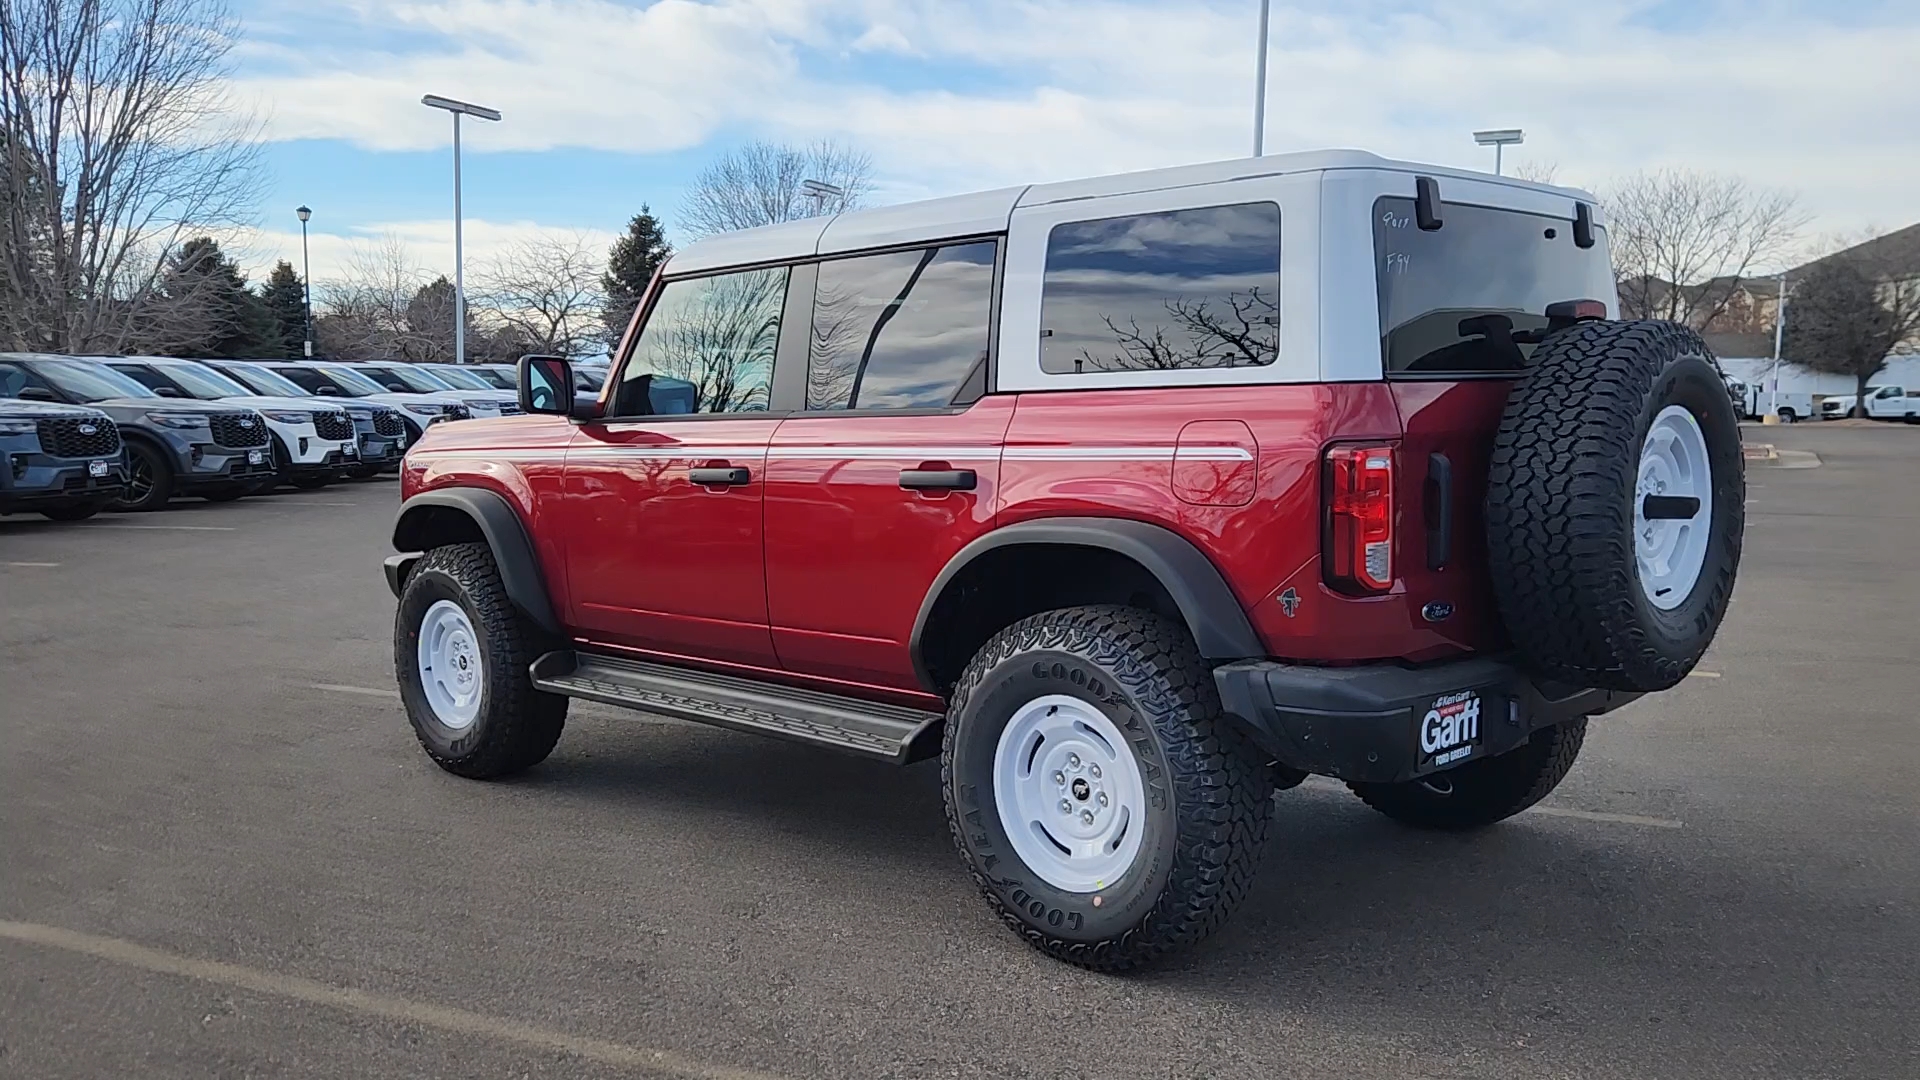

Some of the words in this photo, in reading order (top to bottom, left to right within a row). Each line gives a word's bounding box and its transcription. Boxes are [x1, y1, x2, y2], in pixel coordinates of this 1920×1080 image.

[1031, 661, 1167, 811] GOODYEAR
[1421, 697, 1481, 754] Garff
[960, 783, 1085, 931] GOODYEAR
